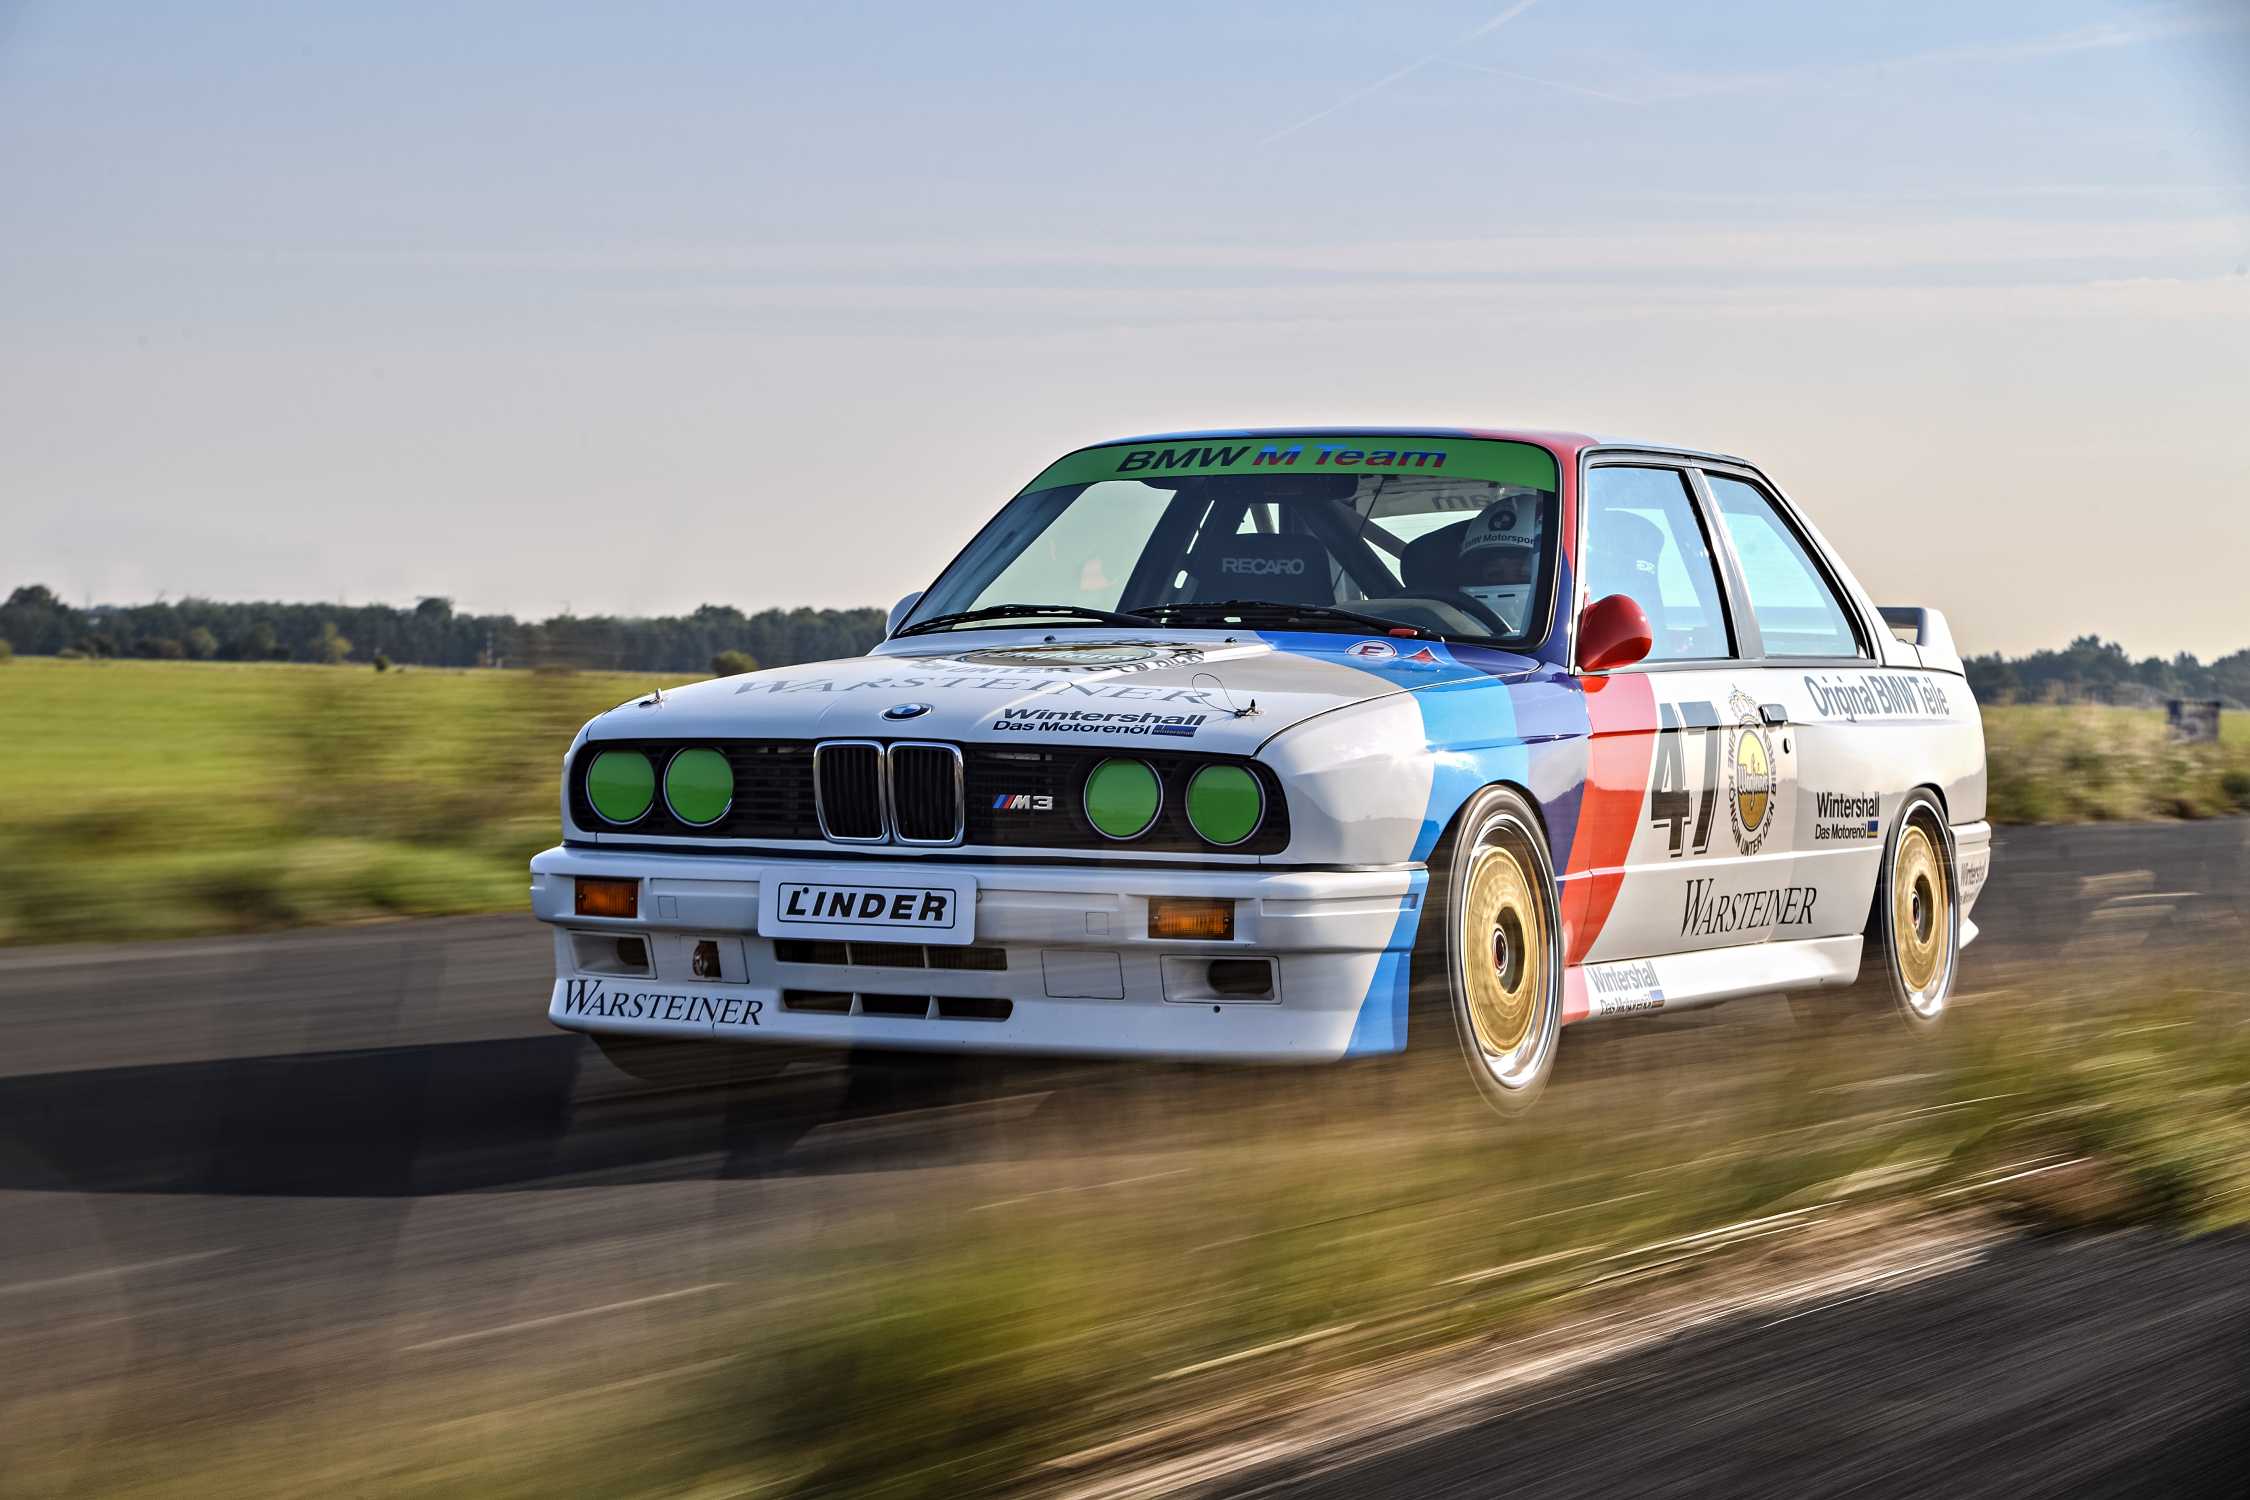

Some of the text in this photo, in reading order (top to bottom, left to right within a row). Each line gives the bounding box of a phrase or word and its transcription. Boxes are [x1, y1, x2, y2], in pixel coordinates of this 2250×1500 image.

[1116, 444, 1447, 473] BMW M Team
[1222, 558, 1305, 574] RECARO
[734, 676, 1212, 704] WARSTEINER
[1804, 675, 1950, 723] Original BMW Teile
[992, 720, 1035, 731] Das
[1038, 721, 1152, 735] Motorenöl
[1004, 708, 1208, 726] Wintershall
[1651, 701, 1722, 858] 47
[1816, 791, 1880, 818] Wintershall
[1740, 833, 1763, 857] UNTER
[1762, 800, 1775, 840] DEN
[1815, 823, 1867, 840] Das Motorenöl
[786, 890, 947, 922] LINDER
[1680, 878, 1817, 937] WARSTEINER
[1586, 960, 1661, 993] Wintershall
[564, 979, 764, 1026] WARSTEINER
